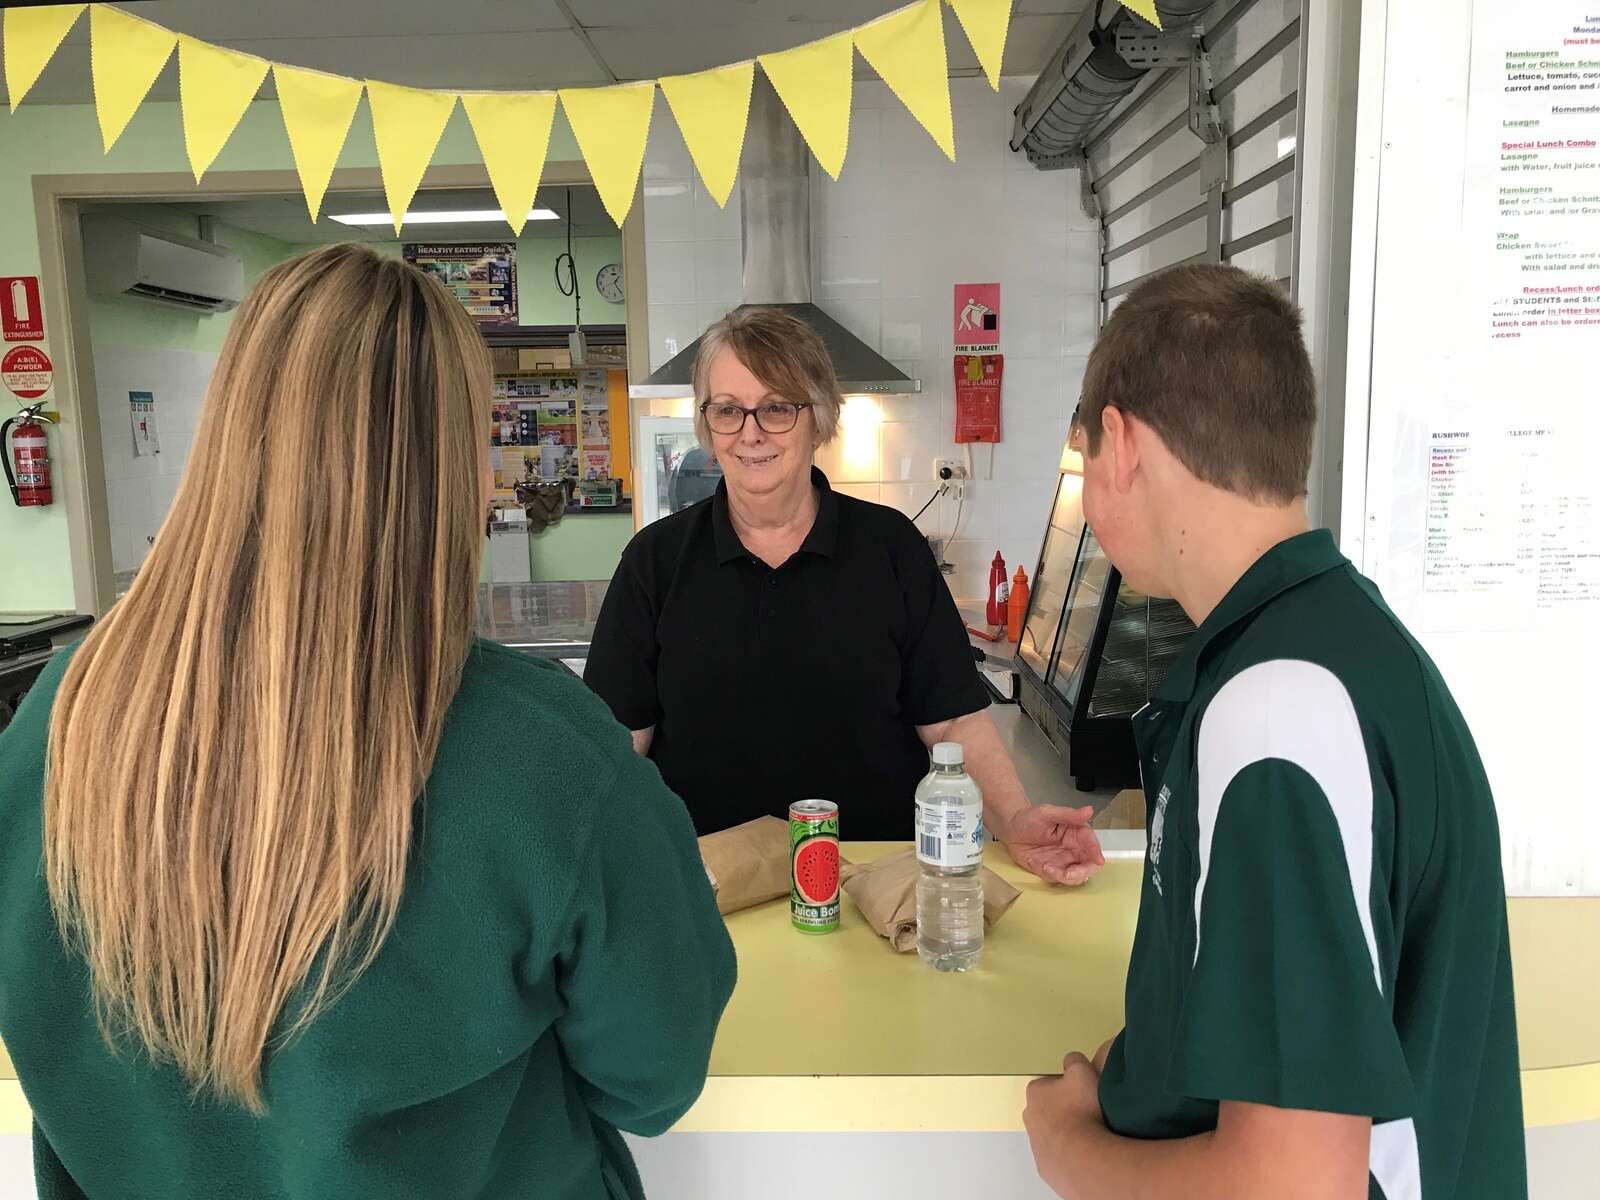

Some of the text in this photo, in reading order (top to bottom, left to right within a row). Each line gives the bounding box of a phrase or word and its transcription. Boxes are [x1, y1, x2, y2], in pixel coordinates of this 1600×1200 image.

[1564, 38, 1588, 46] (must
[1552, 83, 1577, 91] onion
[1551, 106, 1600, 114] Homemade
[1503, 119, 1540, 127] Lasagne
[1501, 139, 1596, 150] Special Lunch Combo
[1501, 153, 1538, 161] Lasagne
[1522, 163, 1551, 171] Water,
[1574, 162, 1595, 170] juice
[1499, 186, 1552, 194] Hamburgers
[1496, 232, 1520, 240] Wrap
[1496, 242, 1532, 250] Chicken
[1544, 263, 1568, 271] salad
[1513, 297, 1561, 305] STUDENTS
[1563, 296, 1580, 304] and
[1522, 308, 1546, 316] order
[795, 903, 818, 918] Juice
